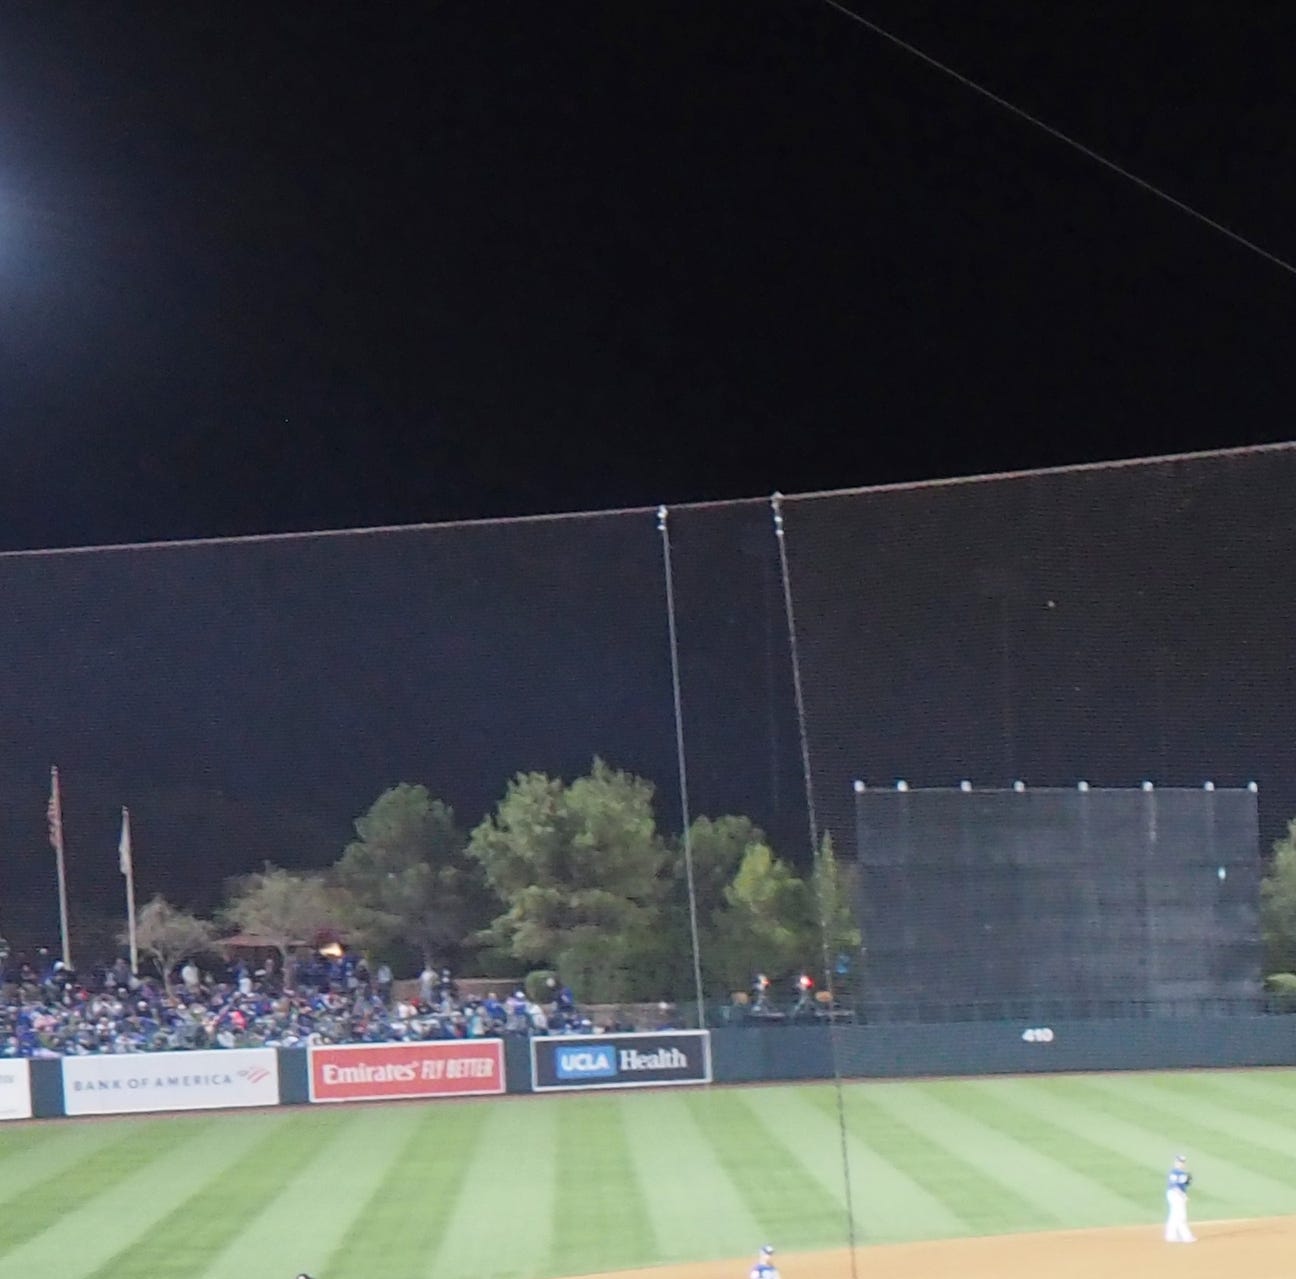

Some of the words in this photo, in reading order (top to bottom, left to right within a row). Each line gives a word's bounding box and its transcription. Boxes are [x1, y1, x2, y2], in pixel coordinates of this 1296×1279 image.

[323, 1062, 417, 1085] Emirates
[421, 1059, 445, 1080] FLY
[446, 1057, 495, 1079] BETTER
[560, 1053, 609, 1071] UCLA
[620, 1047, 688, 1071] Health
[74, 1079, 120, 1092] BANK
[127, 1078, 149, 1089] OF
[154, 1074, 232, 1088] AMERICA
